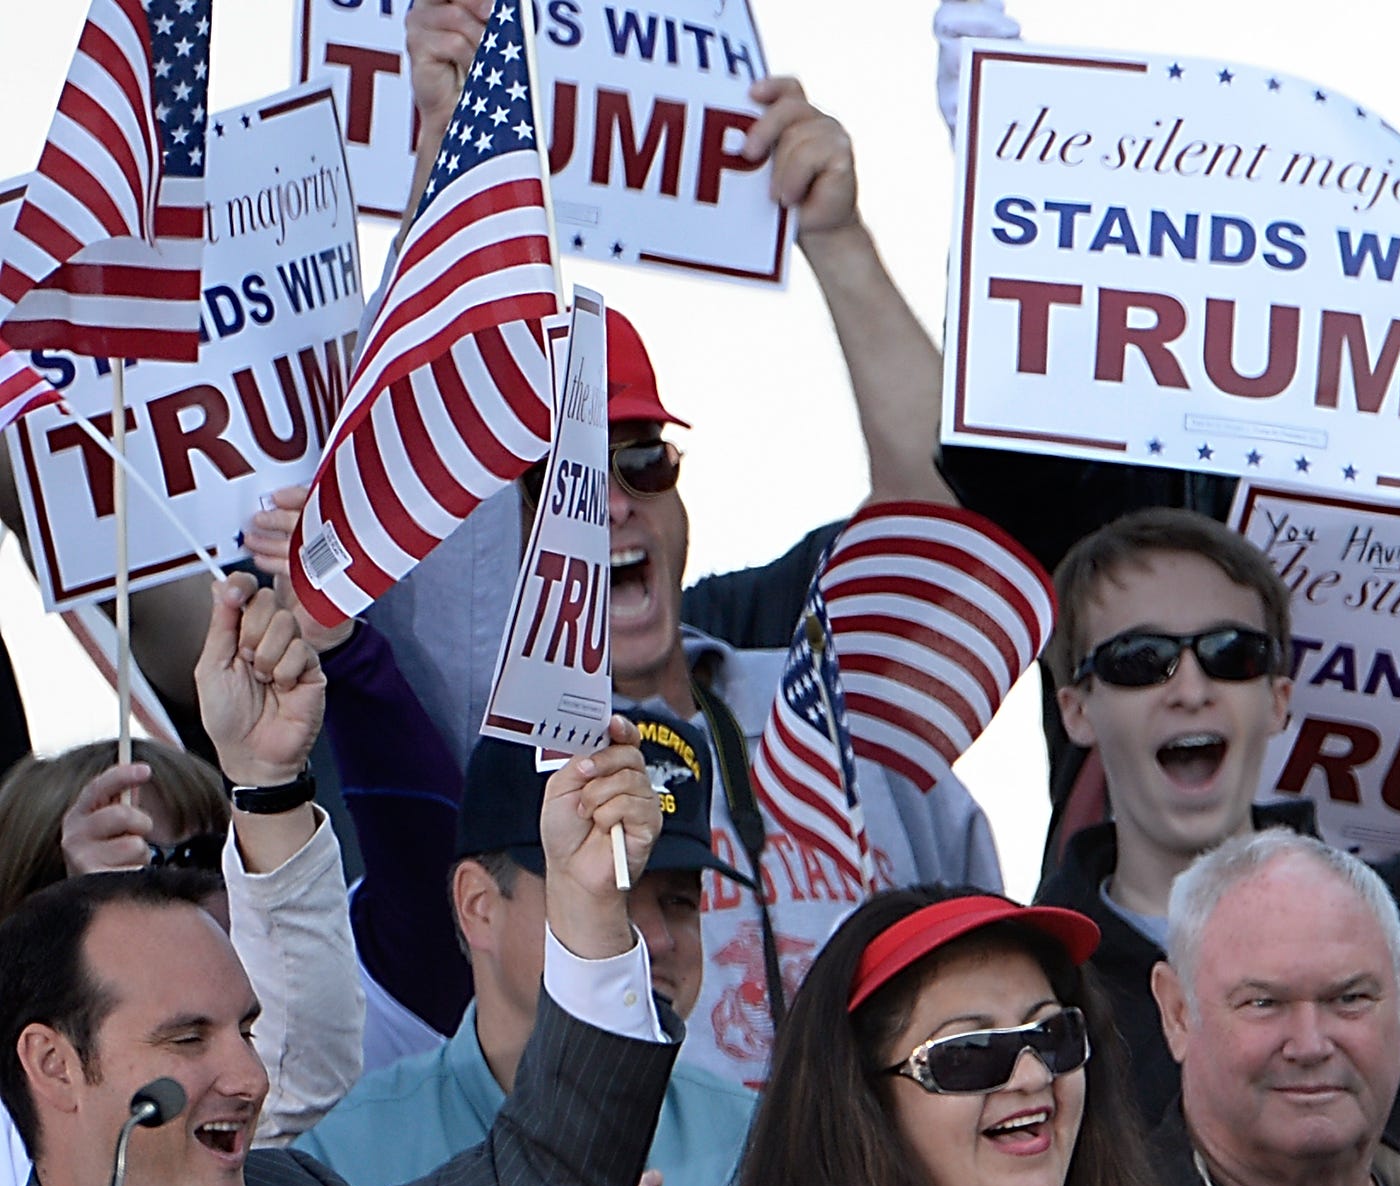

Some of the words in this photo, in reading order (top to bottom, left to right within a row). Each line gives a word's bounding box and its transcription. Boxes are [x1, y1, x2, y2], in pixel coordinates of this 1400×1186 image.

[605, 5, 755, 82] WITH
[995, 107, 1093, 165] the
[1100, 118, 1271, 184] silent
[228, 155, 341, 247] majority
[990, 196, 1308, 272] STANDS
[277, 245, 358, 316] WITH
[637, 722, 700, 782] MERICA
